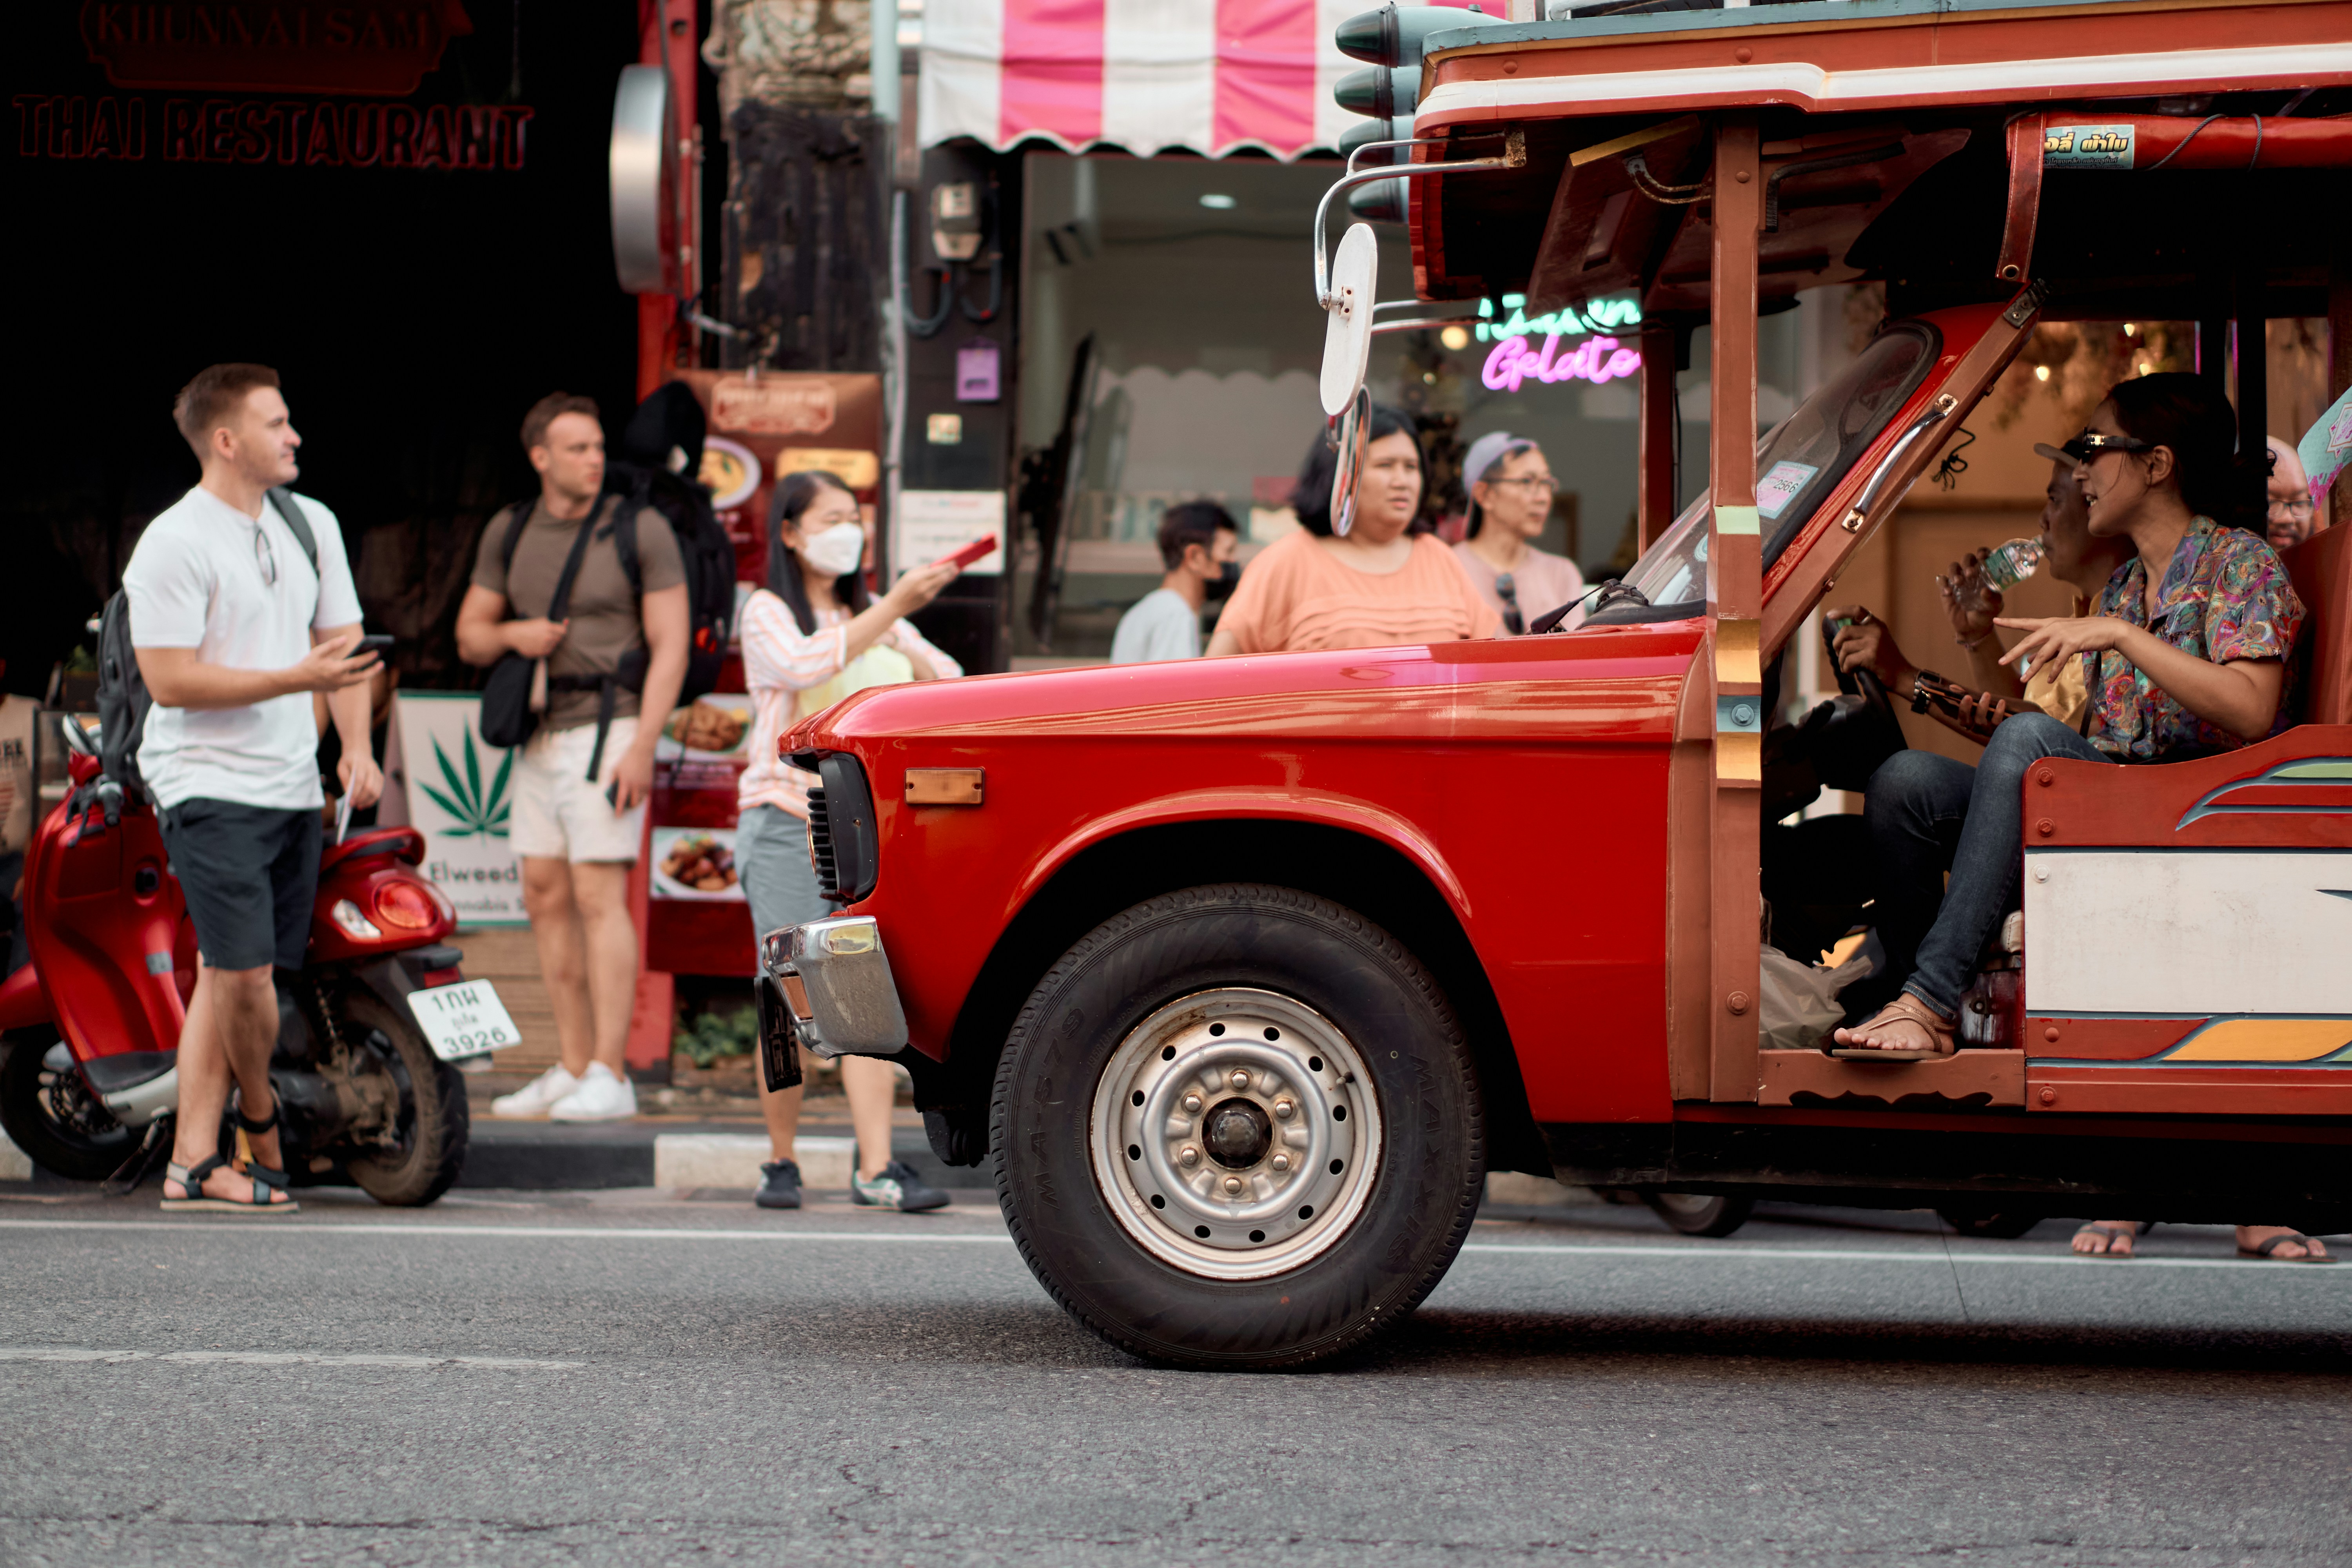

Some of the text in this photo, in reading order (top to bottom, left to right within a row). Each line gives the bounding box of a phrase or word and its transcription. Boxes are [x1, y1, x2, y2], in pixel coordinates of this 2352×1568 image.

[11, 94, 536, 171] THAI RESTAURANT
[2080, 132, 2129, 153] ผ้าใบ
[1482, 334, 1642, 393] Gelato
[1773, 479, 1799, 493] 2566
[429, 861, 519, 883] Elweed
[454, 896, 509, 911] nnabis
[443, 1027, 506, 1054] 3926
[1030, 1007, 1085, 1210] MA-579
[1387, 1054, 1442, 1265] MAXXIS
